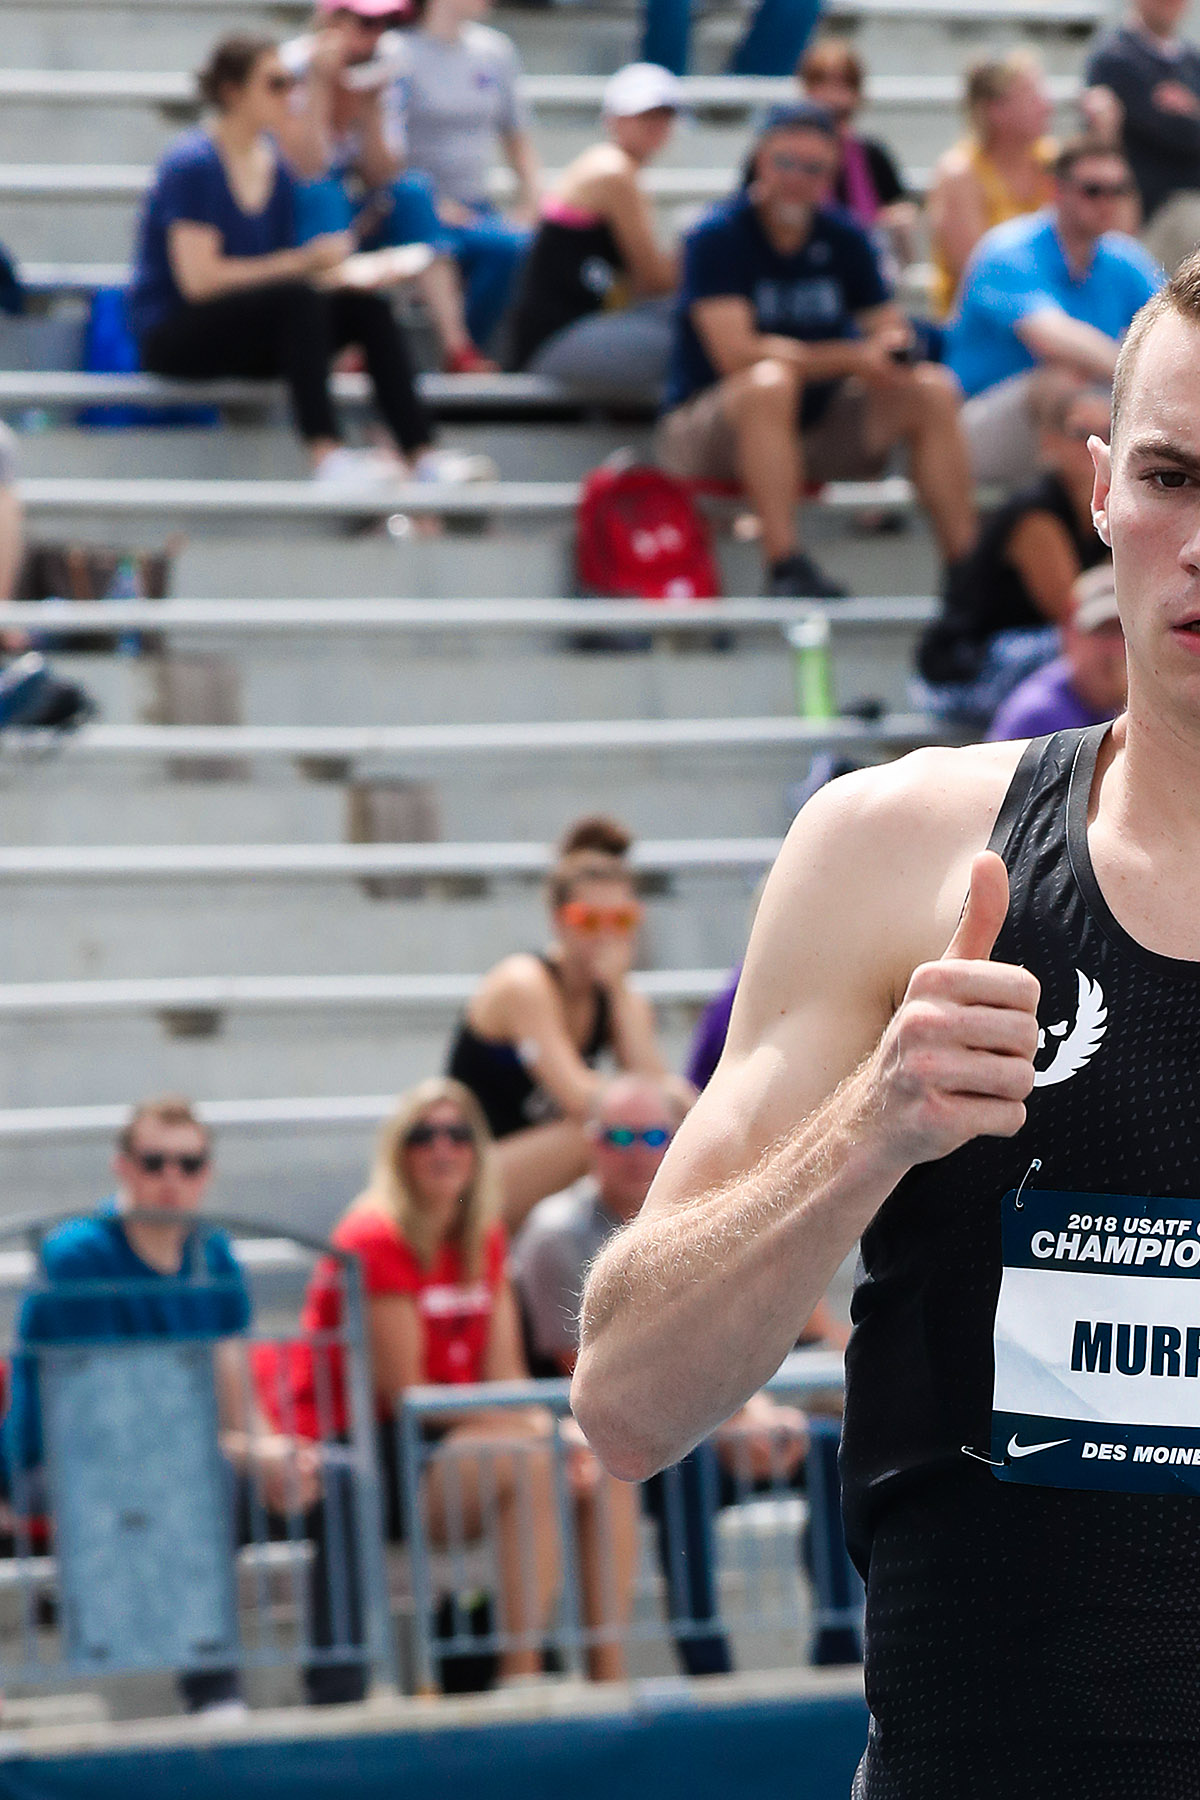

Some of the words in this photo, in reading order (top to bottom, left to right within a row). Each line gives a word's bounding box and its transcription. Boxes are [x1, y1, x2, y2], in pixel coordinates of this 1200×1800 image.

[1067, 1213, 1118, 1233] 2018
[1122, 1217, 1193, 1236] USATF
[1081, 1442, 1128, 1461] DES
